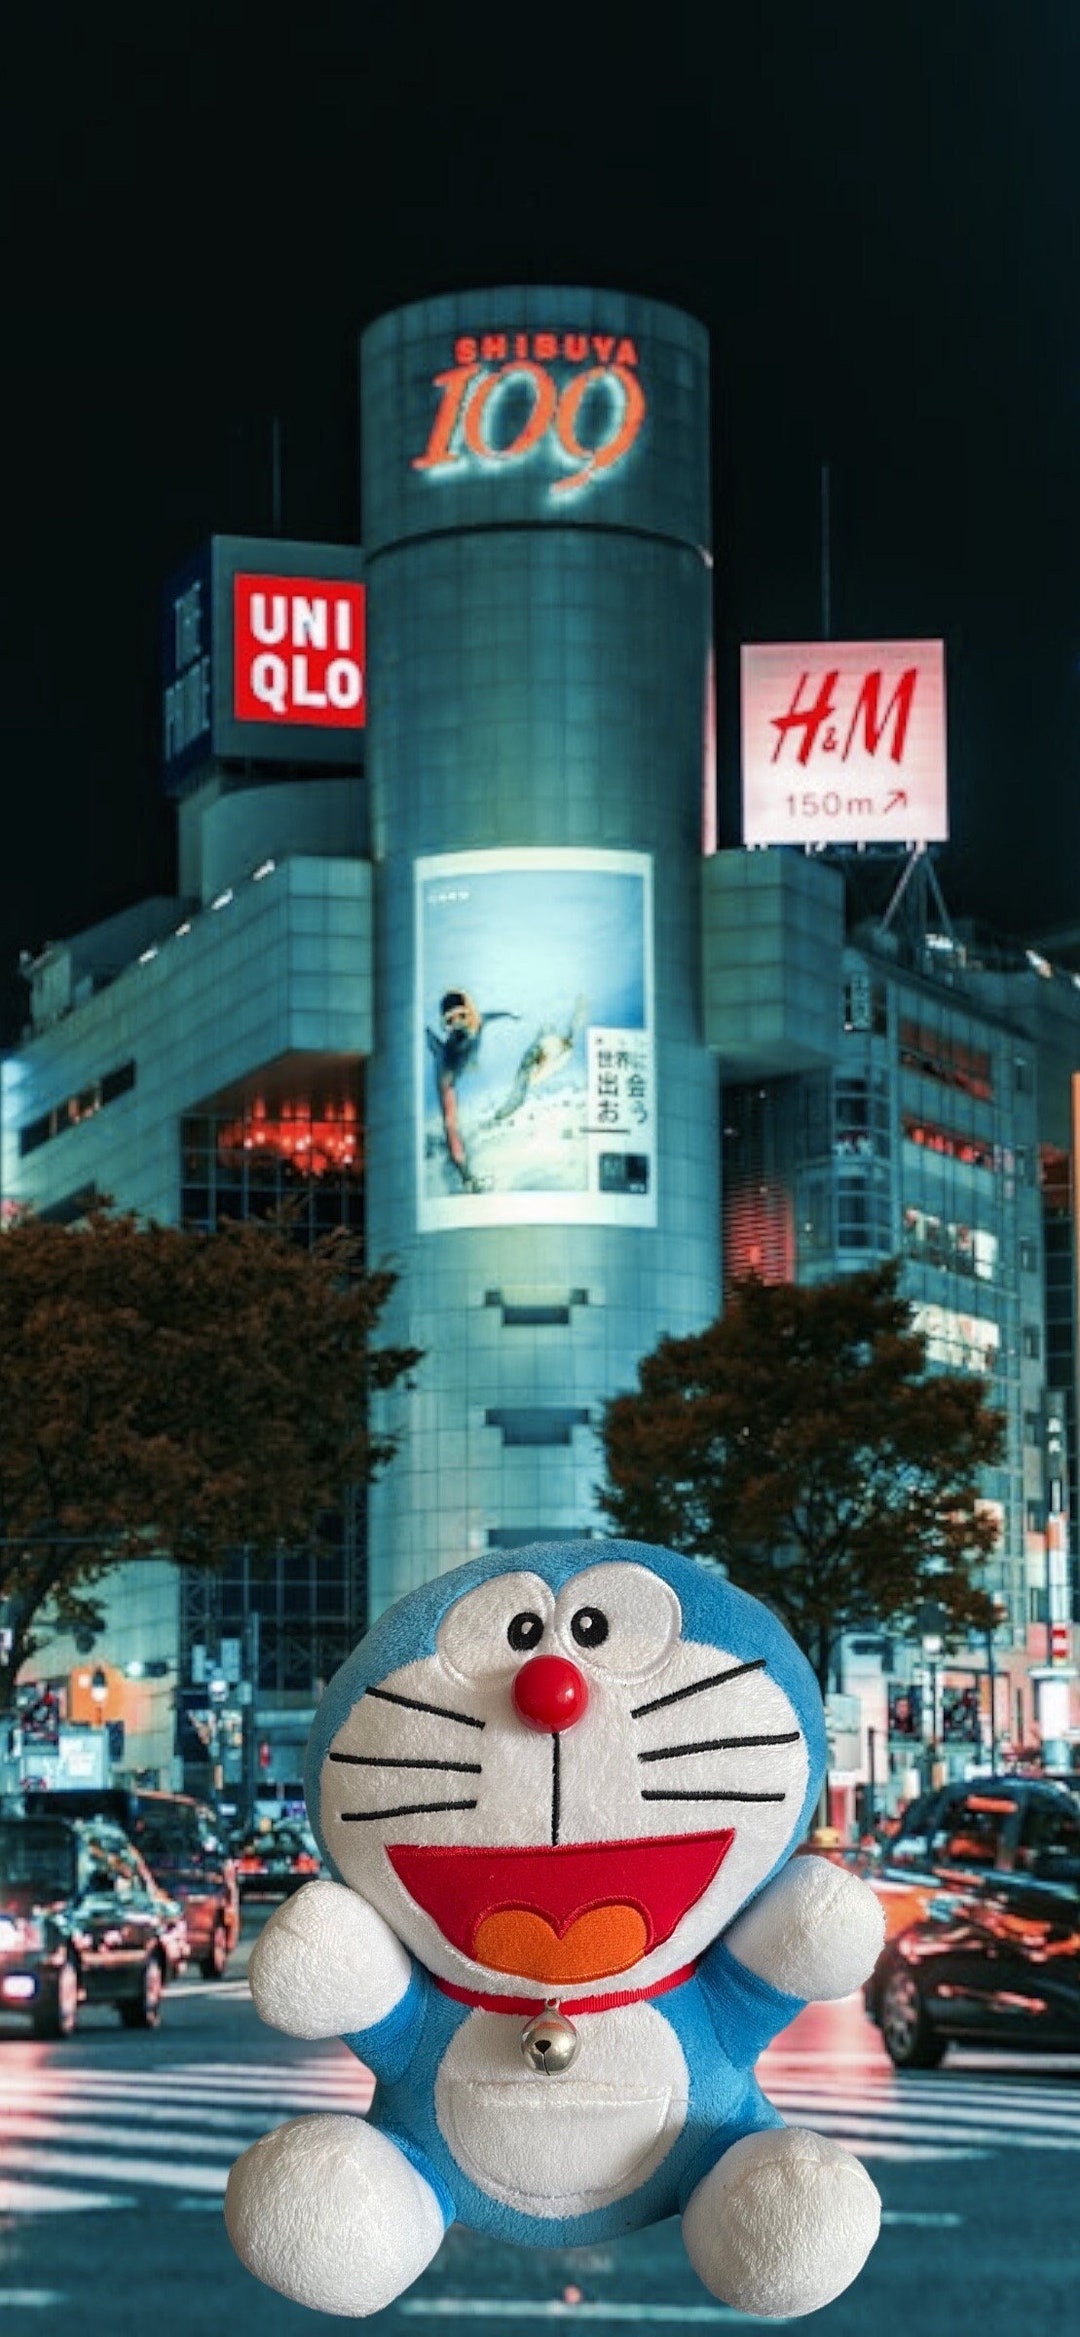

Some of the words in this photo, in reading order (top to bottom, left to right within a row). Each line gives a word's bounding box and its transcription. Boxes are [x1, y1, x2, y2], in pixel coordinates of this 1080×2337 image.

[454, 332, 638, 366] SHIBUYA
[411, 360, 646, 497] 109
[251, 593, 351, 651] UNI
[251, 653, 363, 715] QLO
[769, 667, 919, 767] H&M
